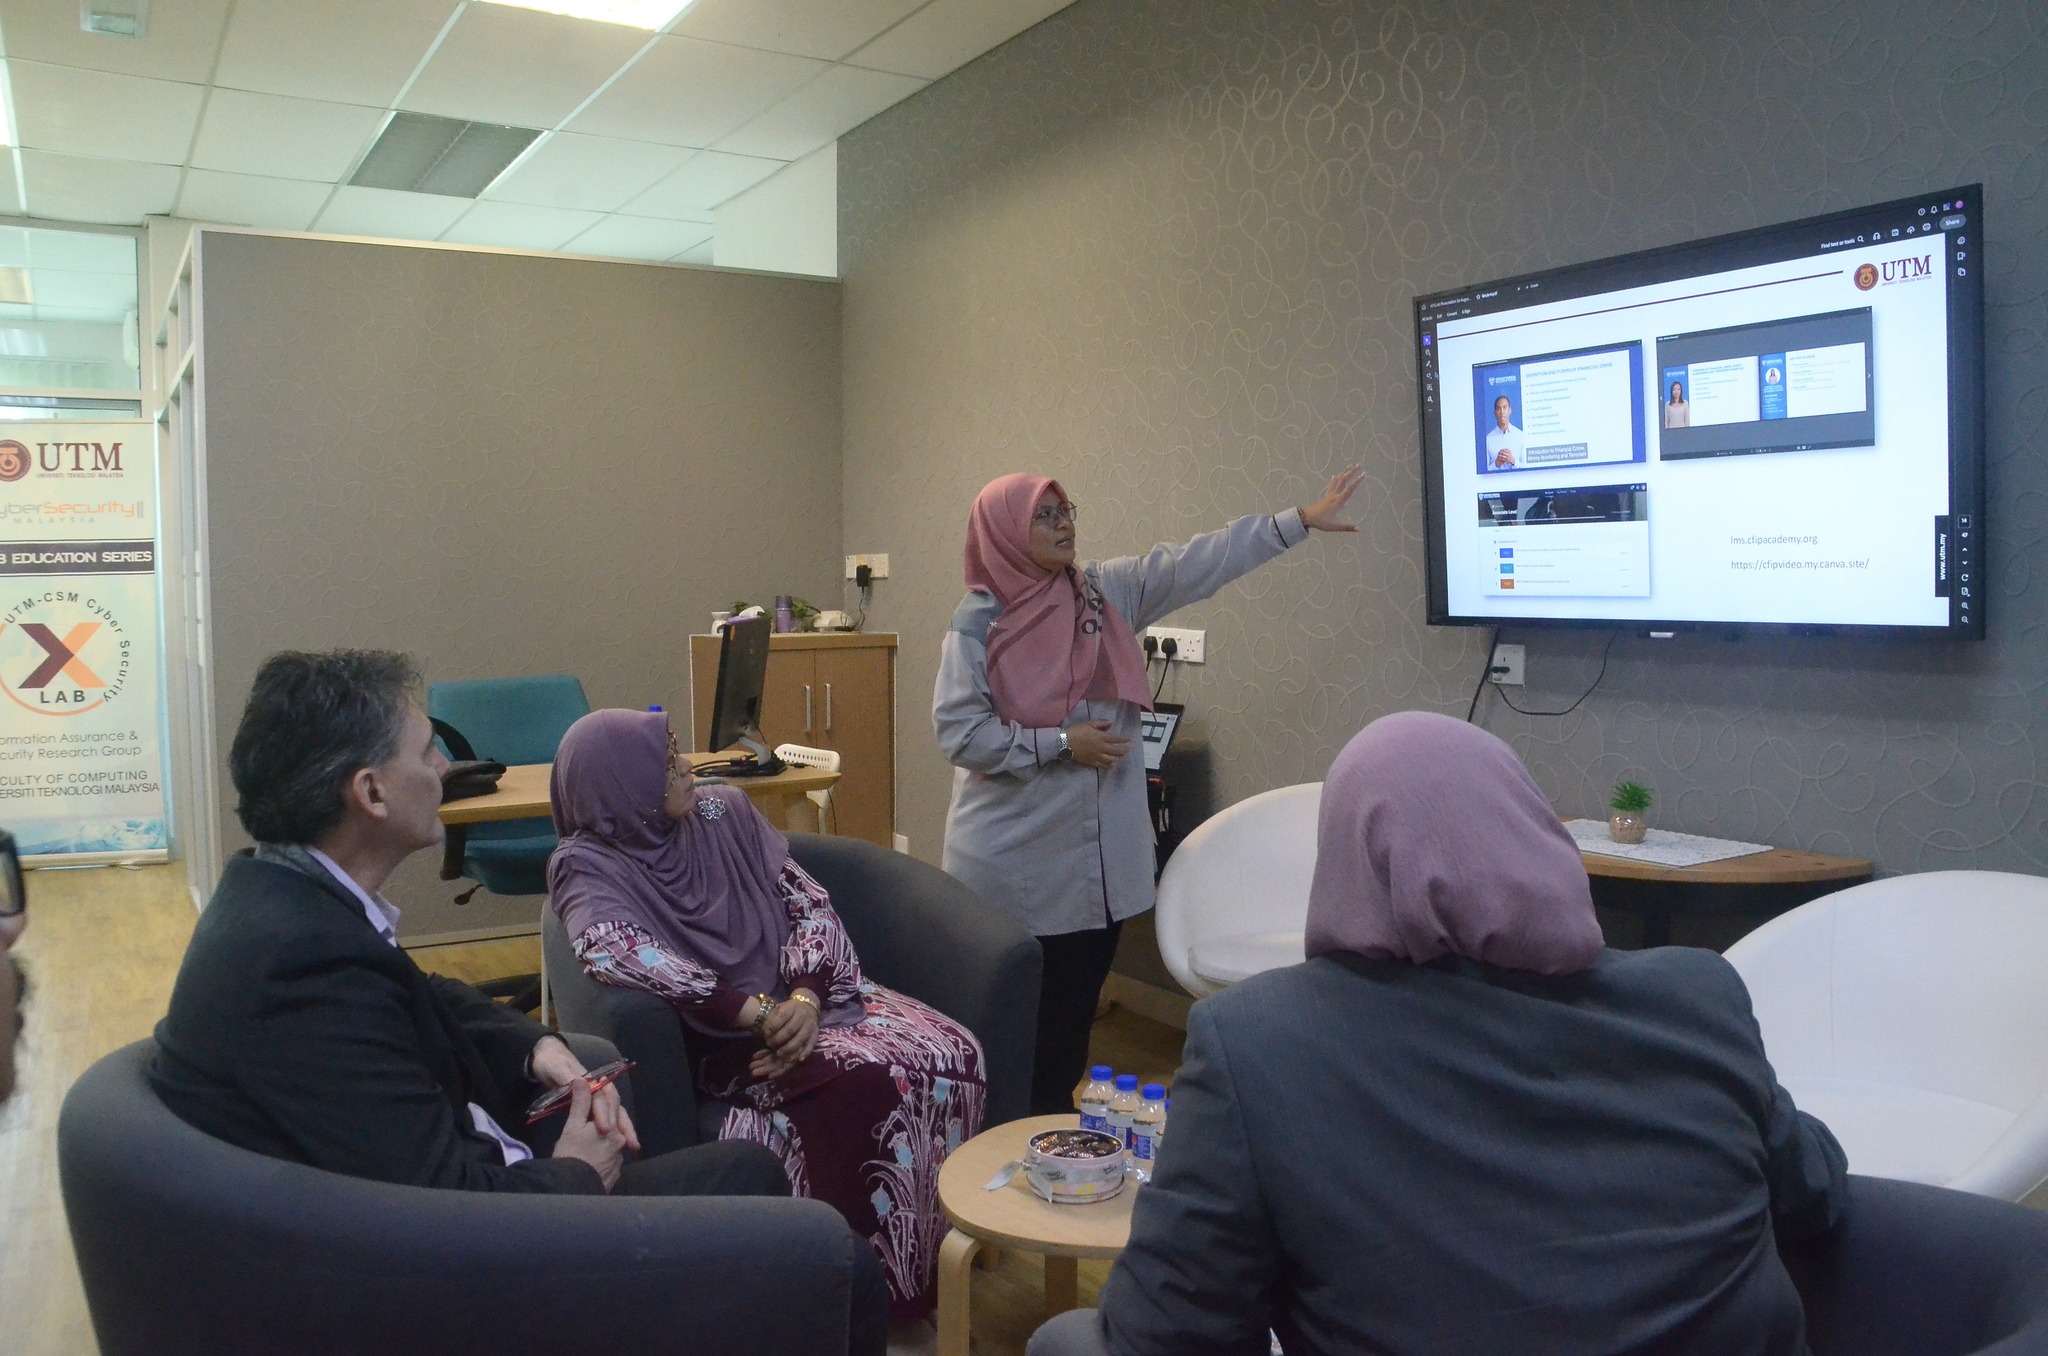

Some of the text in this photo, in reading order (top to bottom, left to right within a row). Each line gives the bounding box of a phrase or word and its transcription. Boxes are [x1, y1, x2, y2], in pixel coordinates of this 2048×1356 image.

[1881, 254, 1932, 282] UTM
[36, 442, 123, 472] UTM
[1730, 535, 1818, 546] lms.cfipacademy.org
[12, 551, 97, 564] EDUCATION
[102, 550, 153, 563] SERIES
[1731, 558, 1870, 570] https://cfipvideo.my.canva.site/
[1939, 533, 1947, 581] www.utm.my
[5, 591, 130, 703] UTM-CSM Cyber Security
[40, 690, 86, 704] LAB
[60, 732, 125, 743] Assurance
[129, 730, 139, 741] &
[38, 747, 98, 759] Research
[102, 745, 142, 758] Group
[46, 773, 65, 784] OF
[68, 770, 148, 784] COMPUTING
[38, 785, 102, 798] TEKNOLOGI
[105, 782, 160, 795] MALAYSIA
